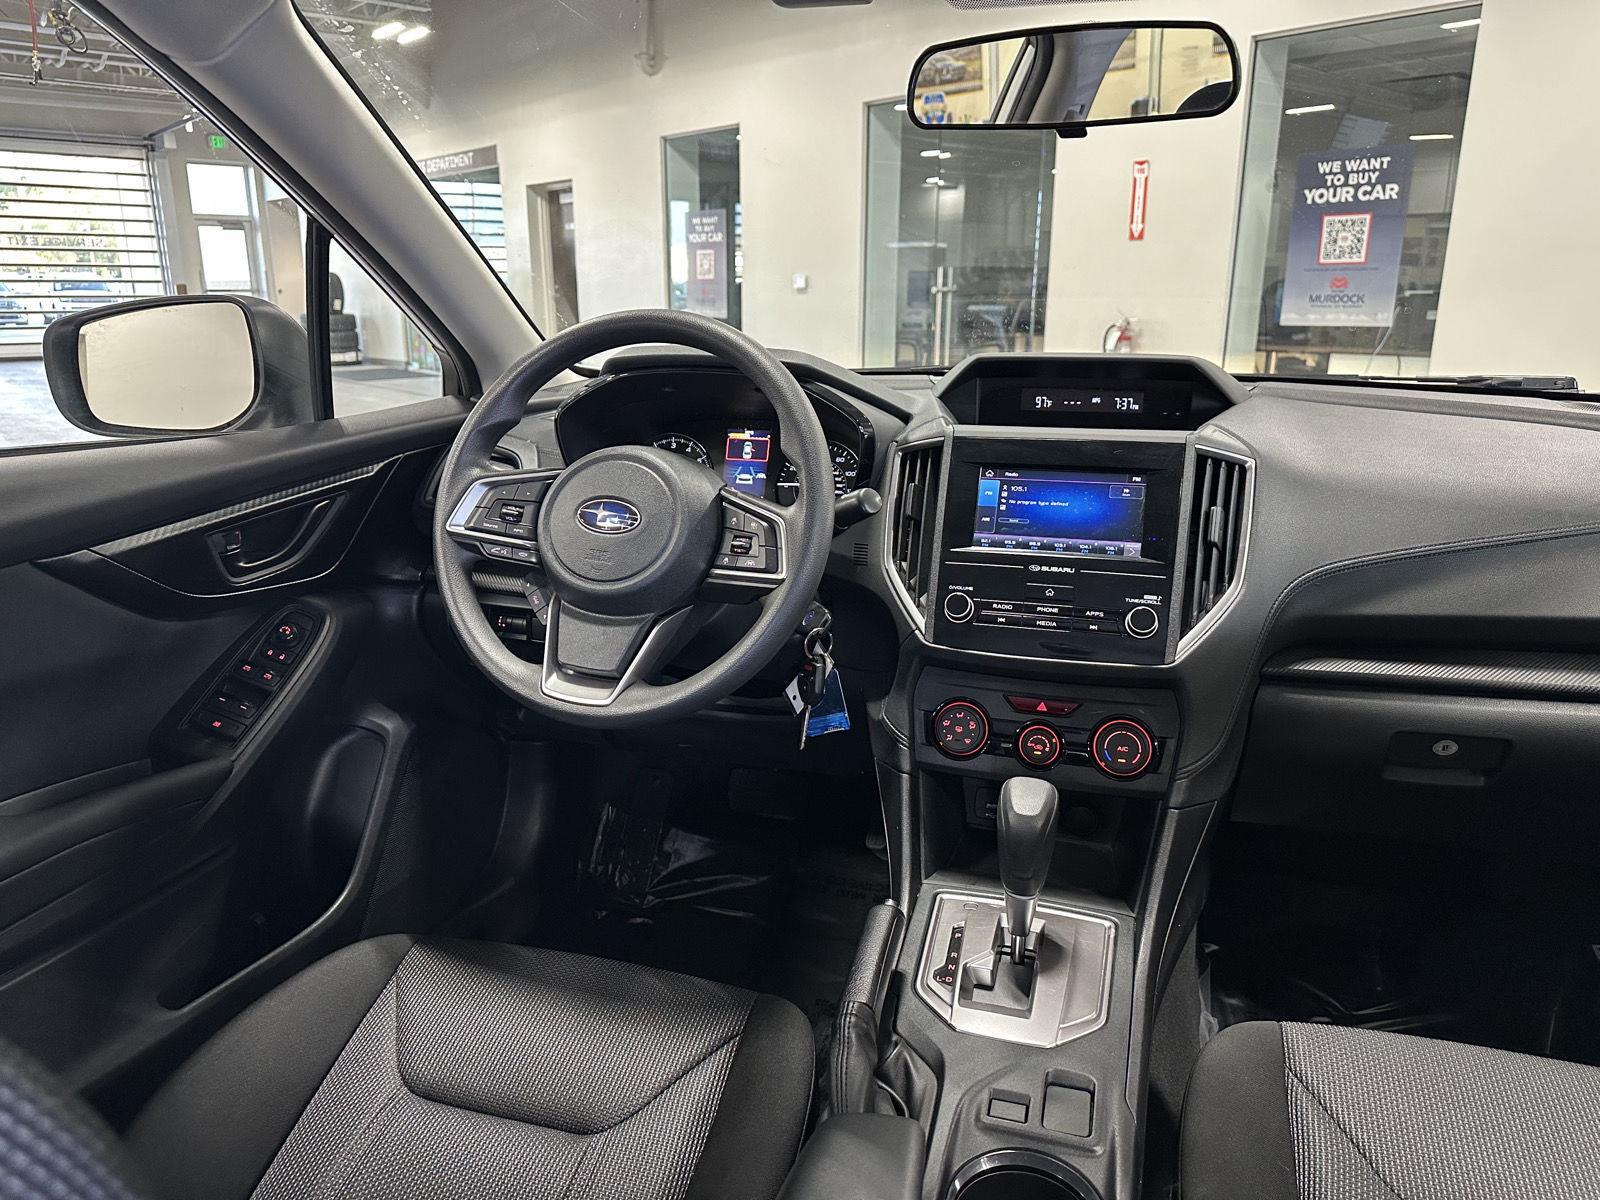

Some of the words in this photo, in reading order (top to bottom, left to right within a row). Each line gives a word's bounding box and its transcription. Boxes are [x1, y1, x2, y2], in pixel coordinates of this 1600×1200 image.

[426, 151, 474, 173] DEPARTMENT
[1317, 161, 1341, 174] WE
[1345, 156, 1391, 172] WANT
[1325, 174, 1345, 187] TO
[1348, 171, 1380, 185] BUY
[1303, 186, 1355, 205] YOUR
[1357, 183, 1400, 202] CAR
[687, 233, 707, 243] YOUR
[708, 232, 724, 242] CAR
[1309, 293, 1365, 304] MURDOCK
[1041, 565, 1075, 573] SUBARU
